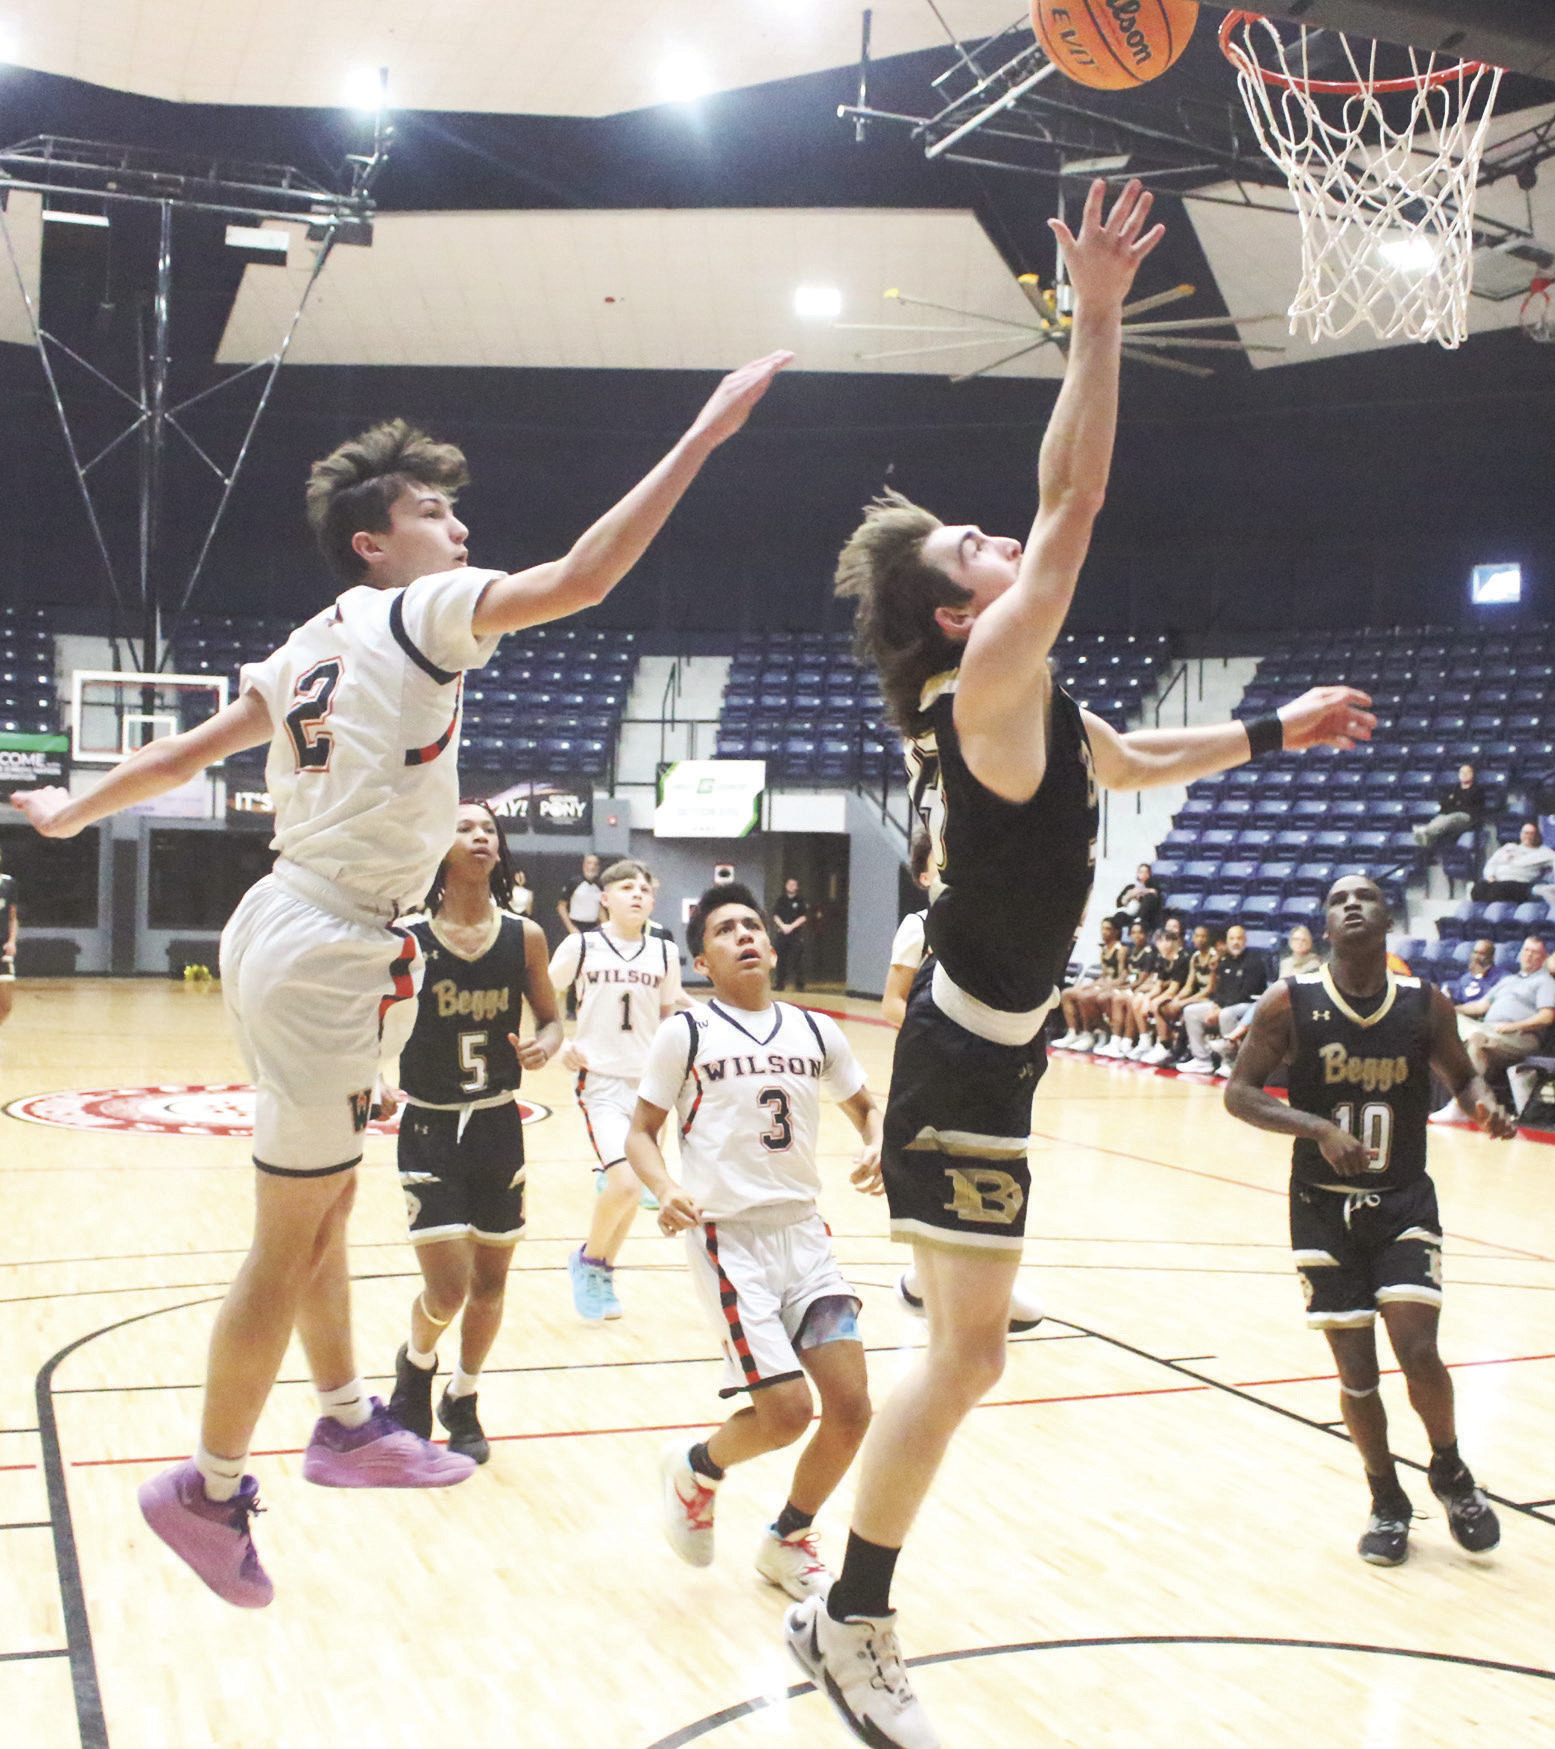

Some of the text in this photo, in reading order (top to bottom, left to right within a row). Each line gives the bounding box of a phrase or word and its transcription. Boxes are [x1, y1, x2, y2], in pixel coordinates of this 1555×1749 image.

[282, 656, 345, 774] 2
[431, 978, 509, 1021] Beggs
[586, 969, 663, 989] WILSON
[619, 990, 634, 1033] 1
[458, 1030, 488, 1093] 5
[702, 1054, 822, 1082] WILSON
[1318, 1042, 1409, 1092] Beggs
[756, 1085, 794, 1153] 3
[943, 1167, 1024, 1224] B
